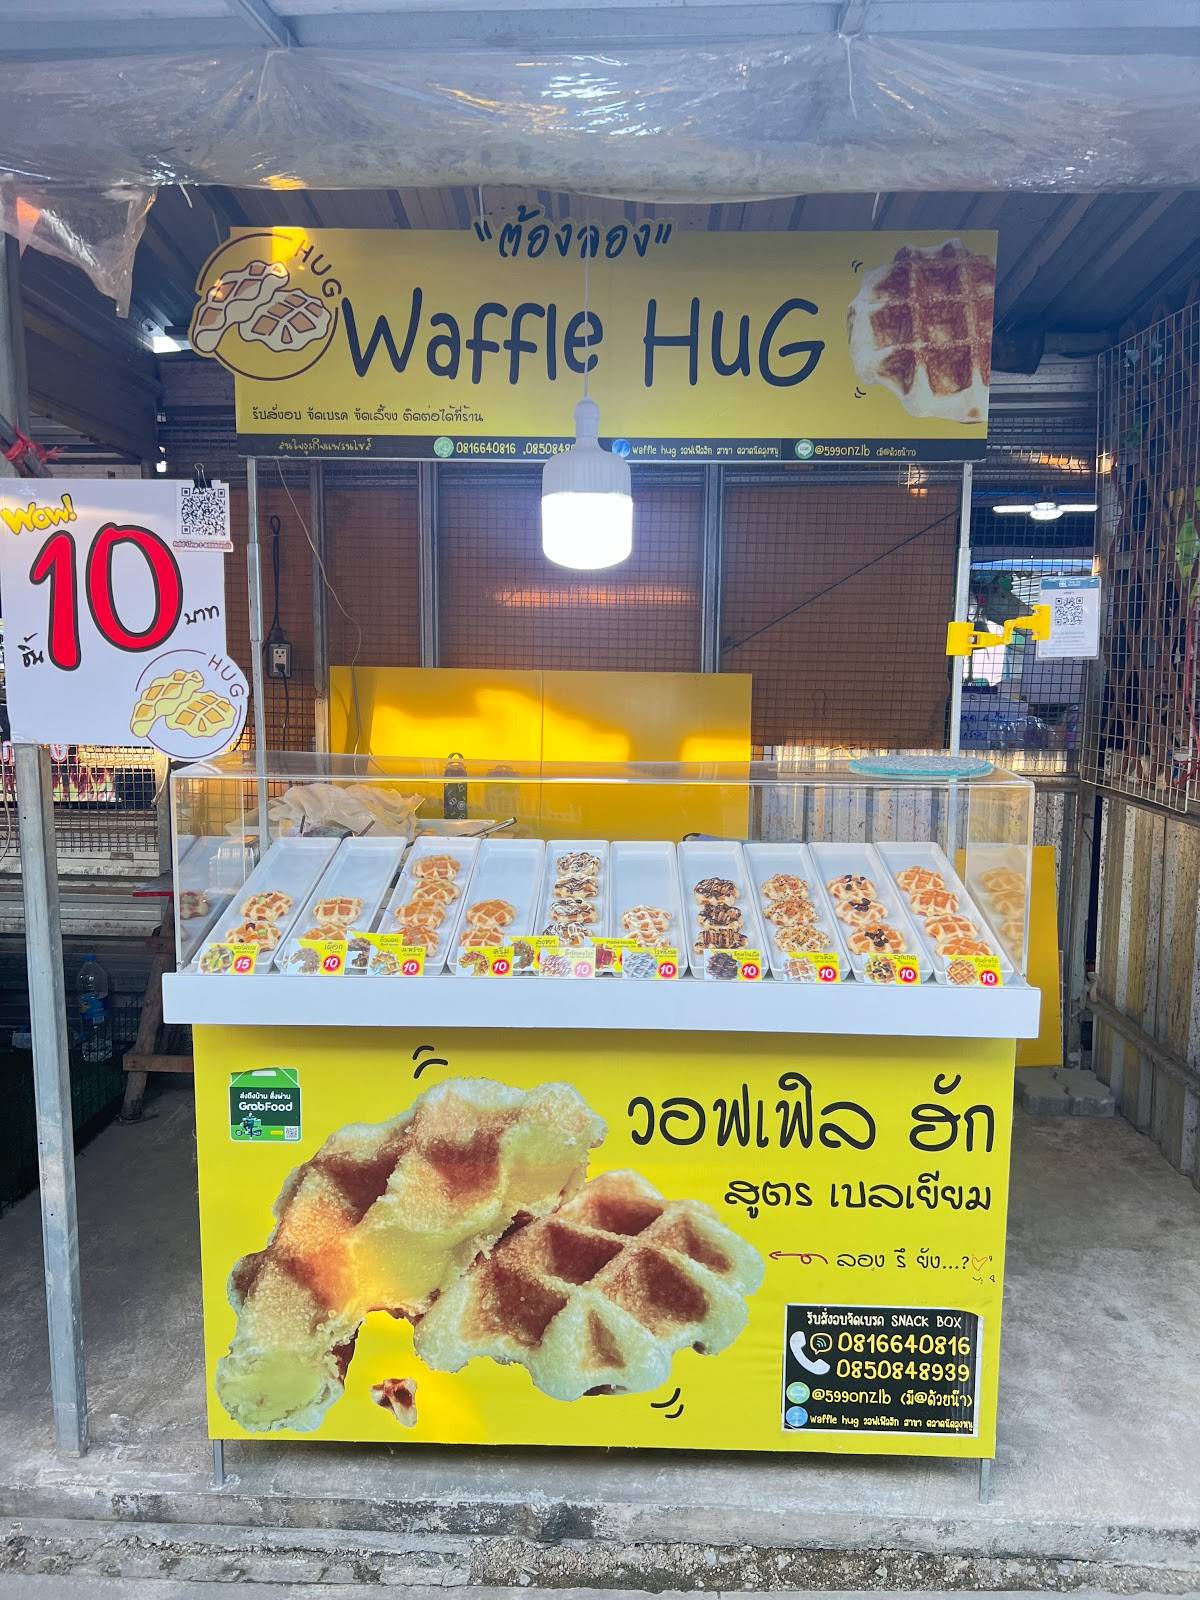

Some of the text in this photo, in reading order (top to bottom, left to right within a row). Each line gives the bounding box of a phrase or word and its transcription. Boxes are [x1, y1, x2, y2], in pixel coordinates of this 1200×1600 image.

[294, 239, 342, 298] HUG
[341, 287, 825, 388] Waffle HuG
[354, 404, 398, 421] จัดเลี้ยง
[456, 442, 516, 454] 0816640816
[29, 522, 183, 671] 10
[184, 605, 220, 625] บาท
[208, 654, 245, 698] HUG
[236, 957, 250, 969] 15
[325, 956, 339, 968] 10
[403, 960, 417, 972] 10
[492, 961, 507, 972] 10
[576, 962, 591, 974] 10
[660, 963, 674, 975] 10
[742, 965, 757, 976] 10
[819, 967, 834, 978] 10
[900, 969, 915, 980] 10
[981, 972, 996, 984] 10
[238, 1101, 293, 1112] GrabFood
[628, 1072, 995, 1153] วอฟเฟิล ฮัก
[724, 1171, 991, 1219] สูตร เบลเยียม
[836, 1253, 885, 1268] ลอง
[936, 1315, 962, 1329] BOX
[837, 1331, 971, 1357] 0816640816
[836, 1358, 970, 1383] 0850848939
[810, 1414, 838, 1425] waffle
[842, 1414, 859, 1428] hug
